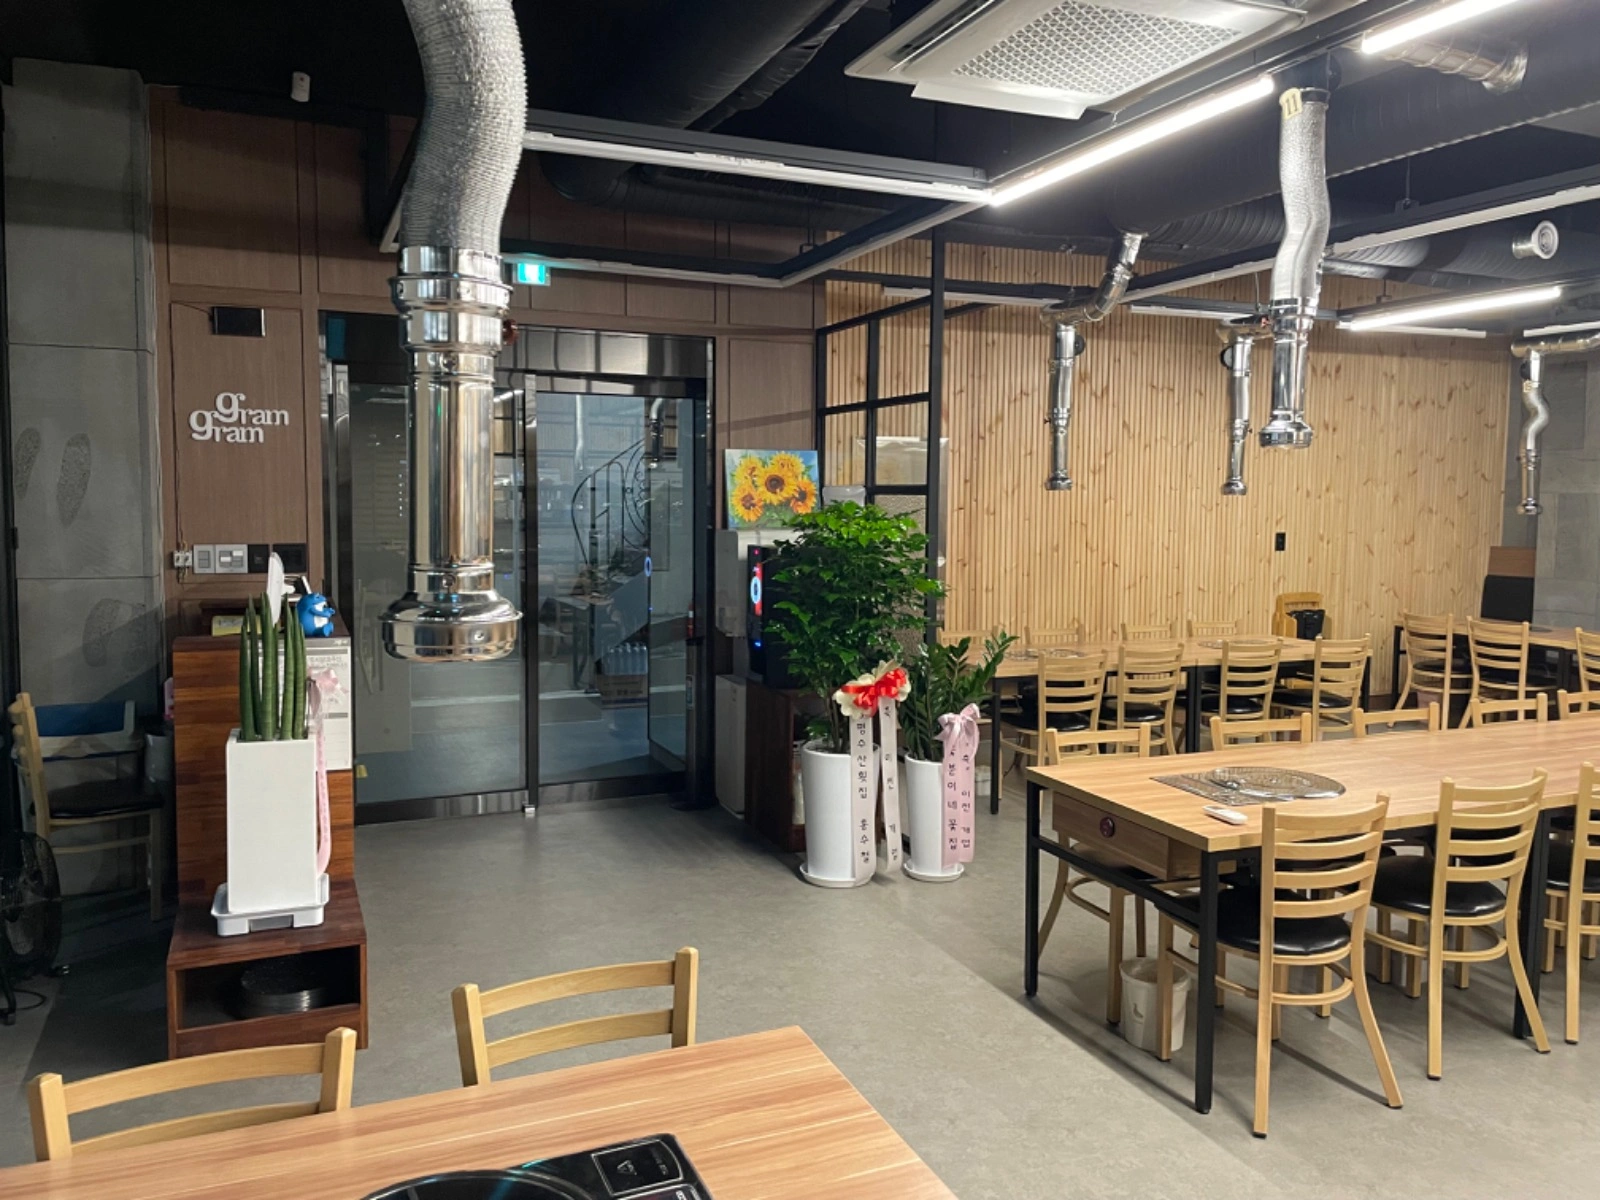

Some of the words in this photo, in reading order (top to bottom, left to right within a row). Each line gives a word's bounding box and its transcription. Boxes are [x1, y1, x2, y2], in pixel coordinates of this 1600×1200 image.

[1285, 93, 1298, 115] 11
[215, 392, 289, 426] gram
[190, 410, 264, 443] gram
